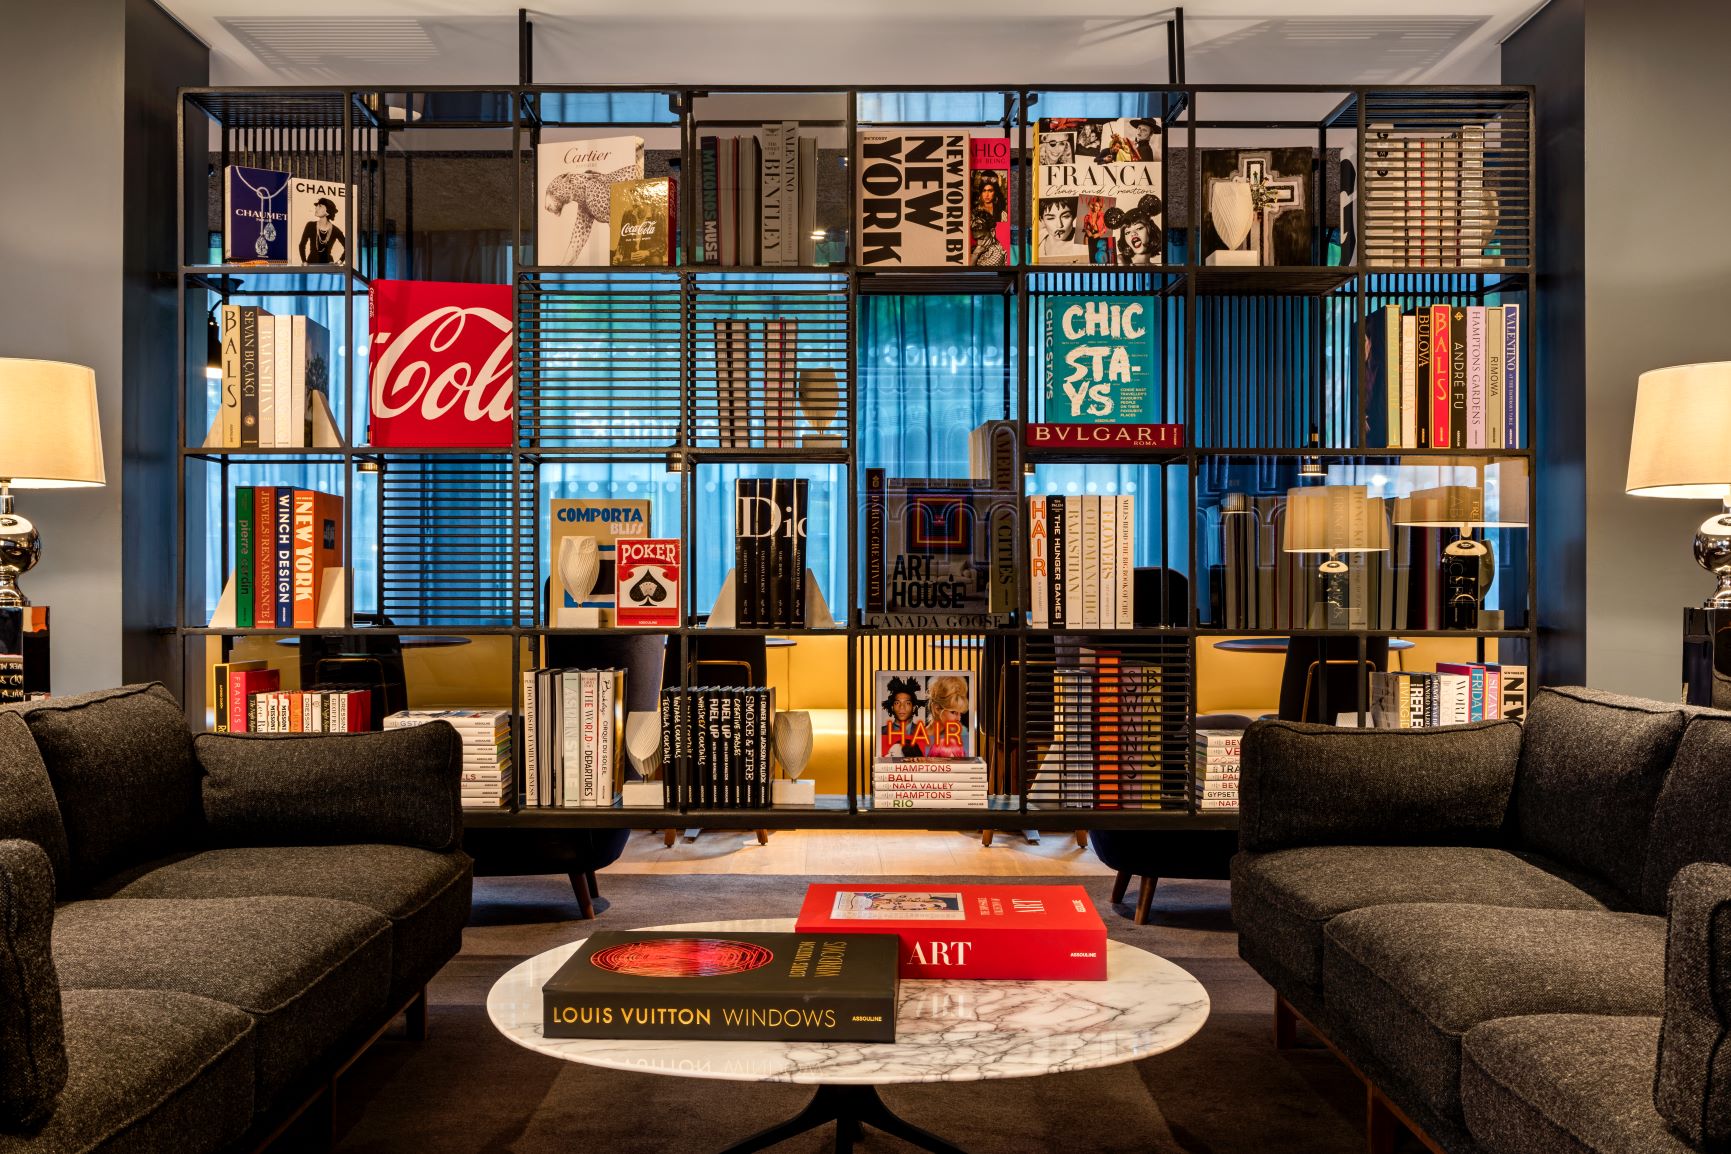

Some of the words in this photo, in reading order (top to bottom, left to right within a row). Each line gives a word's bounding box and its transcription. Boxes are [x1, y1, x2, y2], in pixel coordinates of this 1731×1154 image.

[563, 147, 612, 165] Cartier
[785, 127, 795, 192] VALENTINO
[945, 135, 964, 177] NEW
[971, 142, 1007, 158] HLO
[295, 182, 346, 198] CHANE
[702, 149, 717, 220] MYKONOS
[904, 135, 944, 232] NEW
[1046, 165, 1154, 187] FRANCA
[1046, 184, 1077, 197] Chaos
[1081, 185, 1105, 195] and
[1107, 185, 1156, 197] Creation
[235, 208, 288, 221] CHAUMET
[764, 159, 780, 249] BENTLEY
[861, 136, 903, 265] YORK
[945, 179, 964, 235] YORK
[704, 221, 718, 260] MUSE
[945, 239, 964, 265] BY
[244, 311, 255, 347] SEVAN
[1046, 308, 1054, 347] CHIC
[1062, 300, 1146, 340] CHIC
[1418, 314, 1431, 367] BULOVA
[1435, 311, 1448, 401] BALS
[1471, 311, 1481, 372] HAMPTONS
[1506, 312, 1516, 371] VALENTINO
[224, 309, 238, 408] BALS
[260, 330, 273, 413] RAJASTHAN
[1046, 351, 1054, 400] STAYS
[1063, 344, 1141, 383] STA-
[1453, 342, 1465, 387] ANDRÉ
[1490, 356, 1498, 397] RIMOWA
[1062, 380, 1115, 417] YS
[1453, 393, 1464, 409] FU
[1471, 374, 1481, 425] GARDENS
[1036, 427, 1166, 441] BVLGARI
[996, 430, 1012, 521] AMERIN
[261, 491, 270, 534] JEWELS
[279, 494, 290, 544] WINCH
[295, 501, 313, 543] NEW
[557, 507, 643, 523] COMPORTA
[871, 495, 880, 534] DARING
[1054, 514, 1062, 535] THE
[1353, 491, 1364, 524] HONG
[1471, 500, 1479, 521] FRE
[239, 519, 250, 555] pierre
[610, 523, 643, 535] BLISS
[1031, 500, 1046, 577] HAIR
[1085, 509, 1097, 581] OTTOMAN
[1102, 511, 1114, 580] FLOWERS
[621, 544, 680, 567] POKER
[871, 536, 880, 598] CREATIVITY
[893, 554, 935, 581] ART
[998, 525, 1013, 584] CITIES
[1054, 538, 1062, 581] HUNGER
[1068, 510, 1080, 593] RAJASTHAN
[240, 558, 251, 595] cardin
[261, 538, 270, 618] RENAISSANCE
[279, 550, 290, 603] DESIGN
[295, 545, 313, 601] YORK
[892, 581, 966, 609] HOUSE
[1054, 583, 1062, 619] GAMES
[1085, 584, 1097, 619] CHIC
[1122, 589, 1129, 598] OF
[870, 615, 939, 628] CANADA
[233, 676, 241, 724] FRANCIS
[257, 700, 266, 716] Lee
[584, 690, 594, 708] THE
[1400, 682, 1410, 717] LIVING
[1471, 673, 1483, 708] FRIDA
[1488, 679, 1498, 720] SUZAN
[1504, 677, 1525, 723] NEW
[584, 710, 593, 742] WORLD
[662, 695, 671, 728] TEQUILA
[673, 696, 681, 723] VINTAGE
[697, 696, 706, 729] WHISKEY
[709, 698, 719, 722] FUEL
[721, 698, 731, 722] FUEL
[733, 698, 741, 730] CREATIVE
[745, 695, 755, 737] SMOKE
[1472, 712, 1483, 722] K
[527, 723, 534, 732] OF
[709, 724, 720, 739] UP
[721, 724, 731, 739] UP
[733, 732, 741, 757] TABLES
[745, 739, 754, 747] &
[886, 719, 964, 747] HAIR
[602, 745, 608, 753] DU
[745, 748, 755, 781] FIRE
[1225, 747, 1240, 756] VE
[584, 750, 593, 797] DEPARTURES
[888, 774, 913, 782] BALI
[895, 764, 952, 772] HAMPTONS
[1220, 765, 1240, 773] TRA
[892, 800, 914, 808] RIO
[895, 791, 952, 799] HAMPTONS
[1011, 898, 1045, 913] ART
[814, 941, 847, 978] WINDOWS
[906, 941, 972, 966] ART
[553, 1007, 613, 1024] LOUIS
[621, 1007, 711, 1025] VUITTON
[723, 1008, 836, 1028] WINDOWS
